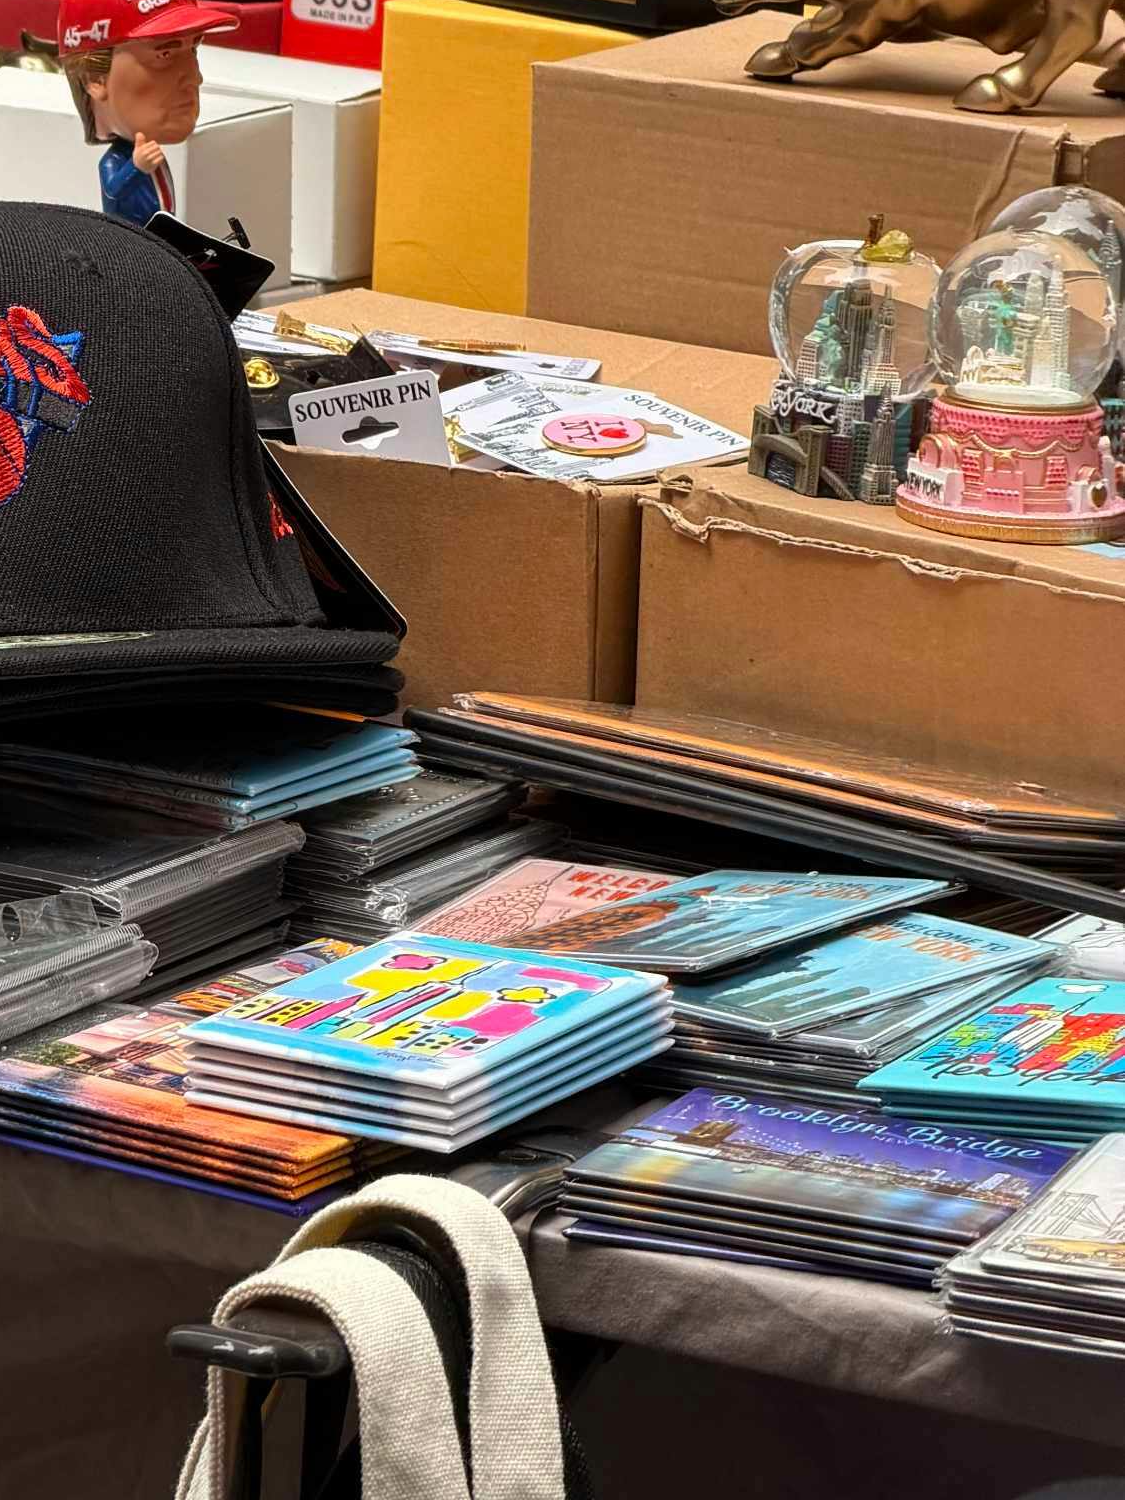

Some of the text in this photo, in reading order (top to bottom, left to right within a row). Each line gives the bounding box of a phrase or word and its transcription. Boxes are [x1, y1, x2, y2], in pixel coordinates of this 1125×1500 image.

[309, 7, 335, 21] MADE
[294, 380, 432, 423] SOUVENIR PIN
[559, 420, 598, 444] NY
[623, 393, 745, 447] SOUVENIR PIN
[568, 868, 670, 893] WELCO
[885, 919, 1012, 953] WELCOME TO
[901, 936, 984, 963] YORK
[710, 1093, 1044, 1160] Brooklyn Bridge
[871, 1134, 914, 1147] NEW
